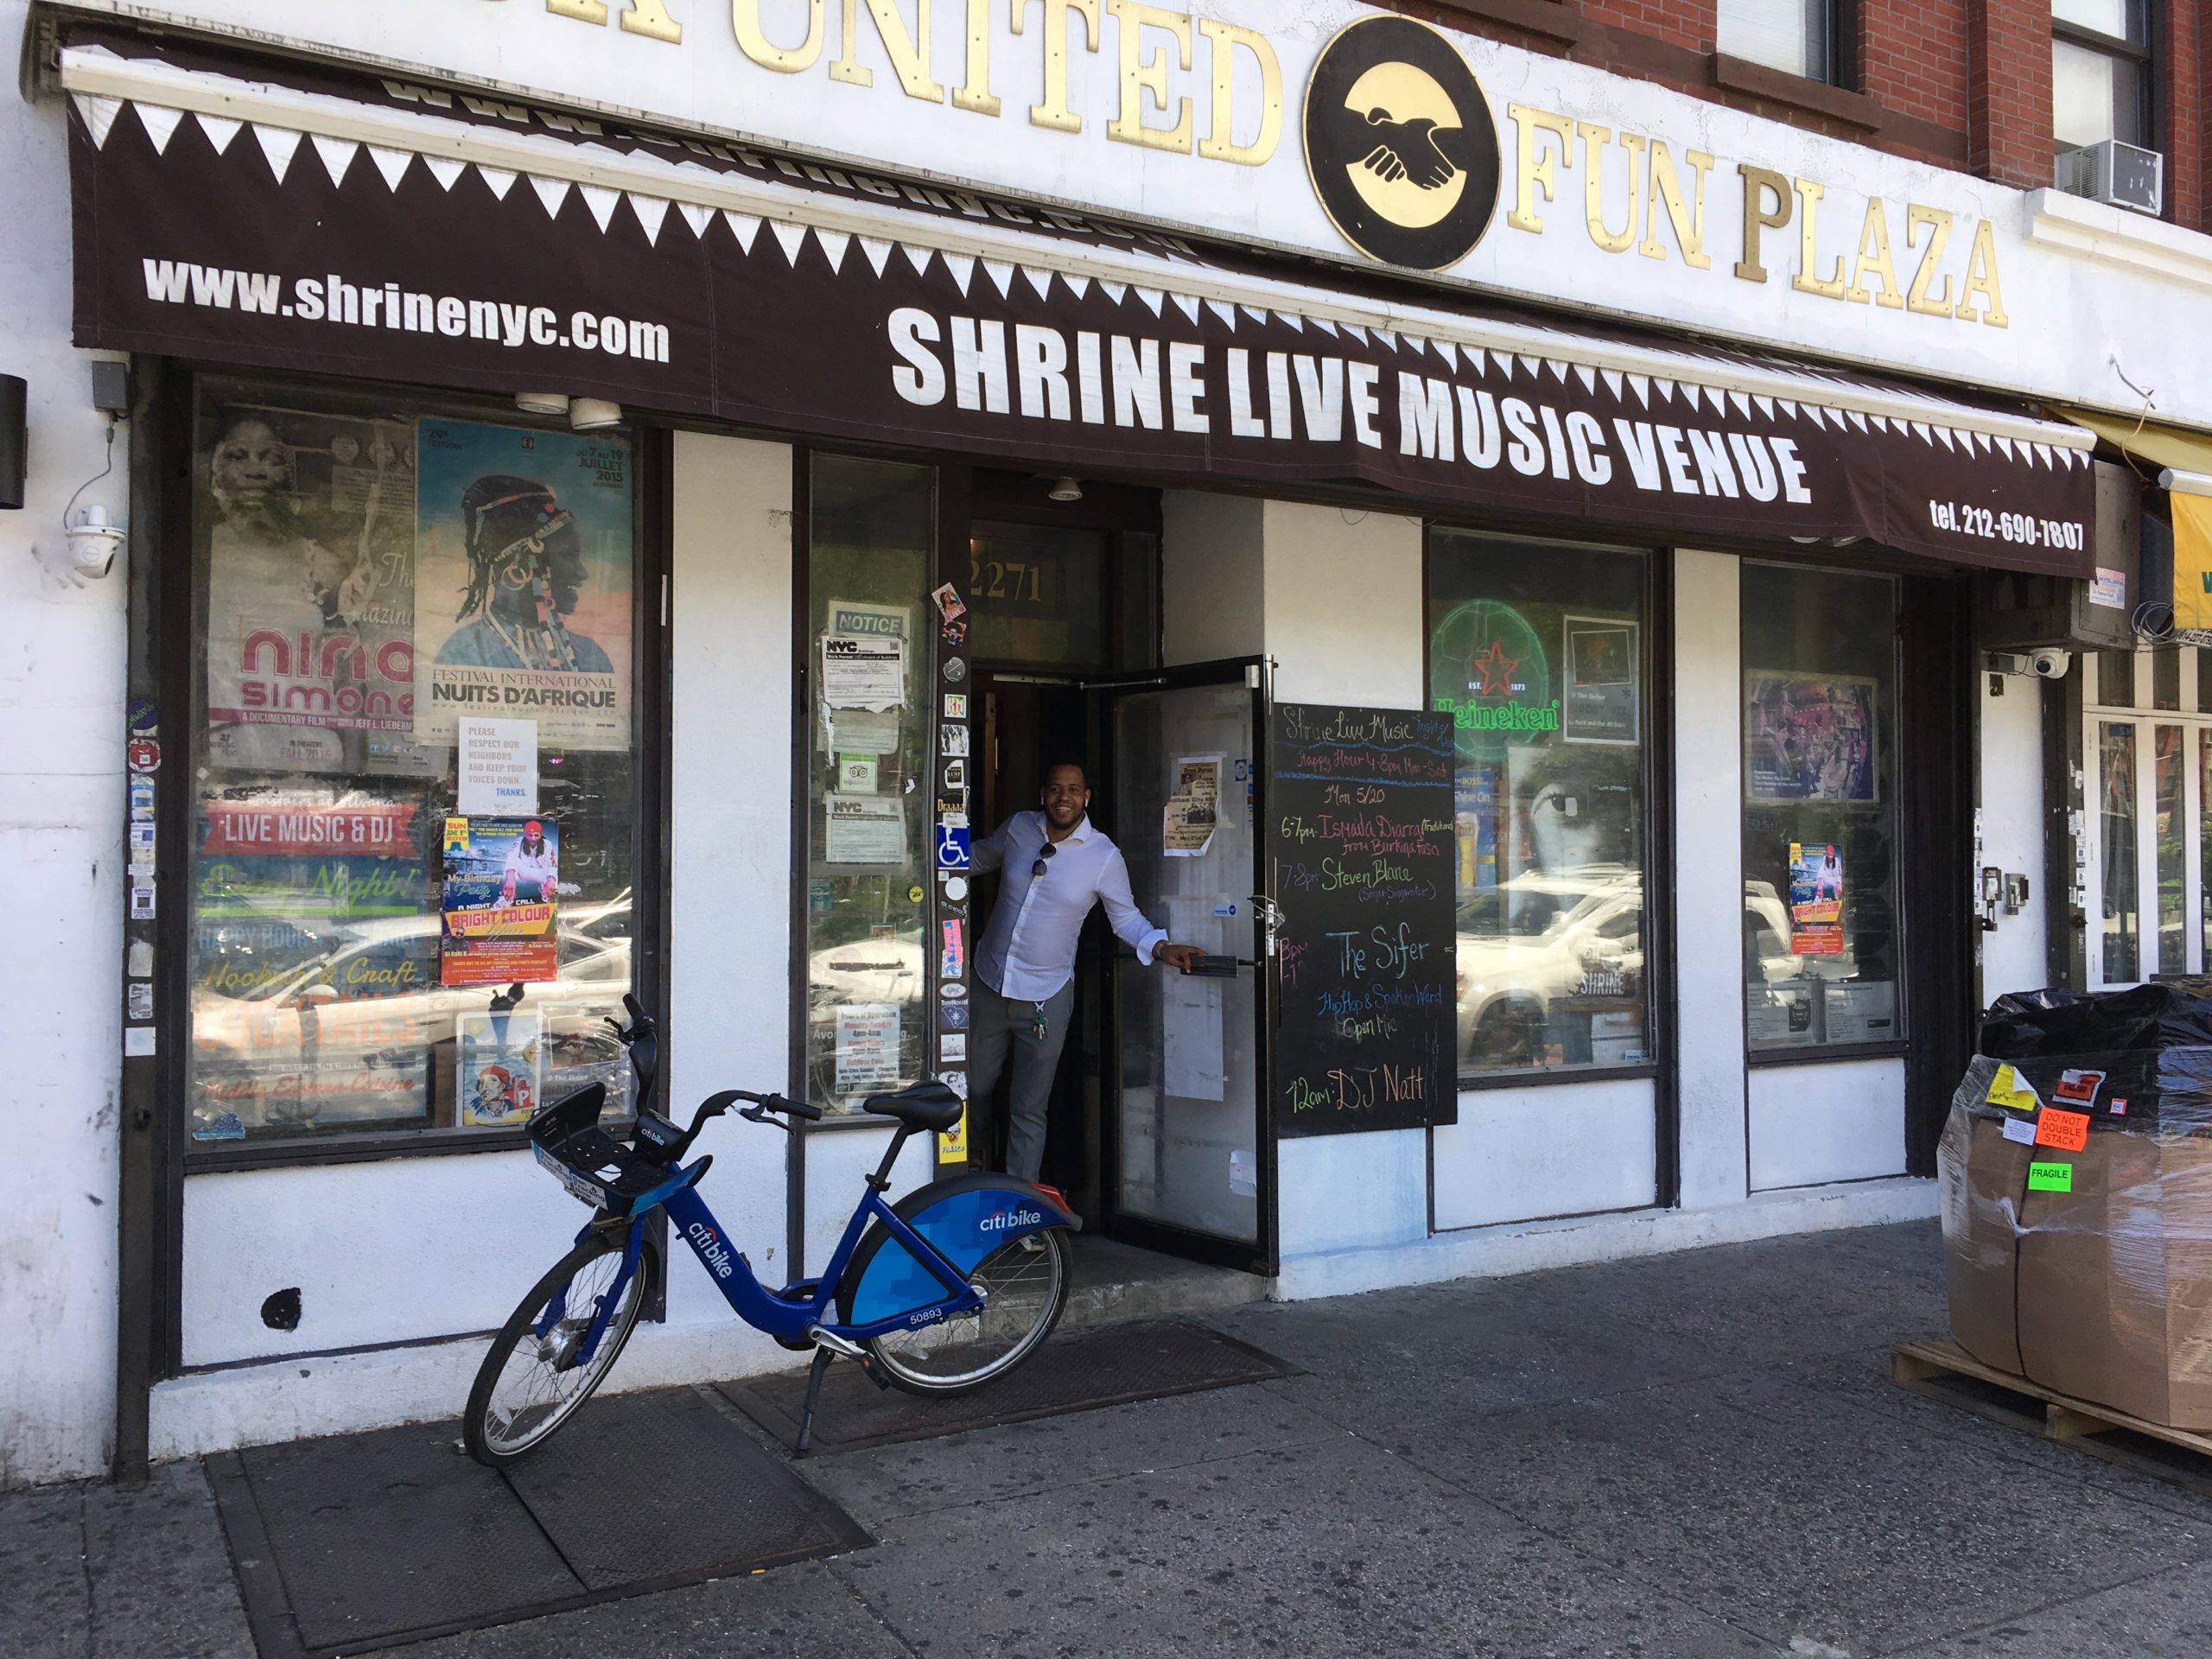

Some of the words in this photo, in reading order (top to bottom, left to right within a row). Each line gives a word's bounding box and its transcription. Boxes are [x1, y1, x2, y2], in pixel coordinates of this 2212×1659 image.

[1507, 101, 1715, 270] FUN
[1734, 163, 2010, 329] PLAZA
[143, 258, 670, 364] www.shrinenyc.com
[888, 308, 1210, 434] SHRINE
[1227, 347, 1382, 448] LIVE
[1398, 371, 1612, 486] MUSIC
[1612, 417, 1811, 504] VENUE
[612, 448, 623, 460] 19
[578, 457, 622, 471] JUILLET
[596, 470, 623, 482] 2015
[1929, 499, 1961, 532] tel.
[1962, 505, 2083, 550] 212-690-7807
[970, 559, 1042, 601] 2271
[839, 614, 900, 633] NOTICE
[827, 640, 857, 652] NYC
[433, 670, 495, 683] FESTIVAL
[501, 673, 616, 689] INTERNATIONAL
[1469, 682, 1483, 690] EST.
[241, 680, 414, 716] simone
[433, 683, 500, 702] NUITS
[505, 687, 616, 709] D'AFRIQUE
[249, 713, 305, 726] DOCUMENTARY
[307, 715, 326, 726] FILM
[355, 719, 372, 728] JEFF
[1335, 710, 1369, 741] Live
[1369, 713, 1414, 744] Music
[468, 727, 496, 735] PLEASE
[281, 747, 303, 759] FALL
[468, 740, 501, 748] RESPECT
[503, 741, 519, 749] OUR
[468, 752, 512, 760] NEIGHBORS
[1298, 749, 1332, 773] Happy
[468, 775, 495, 784] VOICES
[1462, 777, 1480, 785] BOSS
[1325, 785, 1350, 804] Mon
[1357, 785, 1385, 804] 5/20
[1477, 791, 1491, 803] On
[834, 801, 862, 813] NYC
[225, 814, 272, 842] LIVE
[278, 815, 345, 843] MUSIC
[351, 817, 365, 843] &
[371, 816, 393, 843] DJ
[1341, 838, 1369, 856] from
[1370, 838, 1417, 858] Burkina
[448, 874, 461, 884] My
[461, 874, 501, 885] Birthday
[1322, 857, 1372, 891] Steven
[1372, 858, 1414, 888] Blane
[451, 912, 498, 929] BRIGHT
[501, 906, 550, 925] COLOUR
[1325, 931, 1366, 979] The
[1371, 921, 1430, 980] Sifer
[346, 957, 418, 987] Craft
[1580, 972, 1624, 995] SHRINE
[1412, 982, 1442, 1006] Word
[1342, 1017, 1375, 1040] Open
[1376, 1014, 1397, 1039] Mic
[1327, 1068, 1377, 1110] DJ
[1383, 1065, 1424, 1103] Natt
[2046, 1112, 2061, 1122] DO
[2062, 1114, 2082, 1126] NOT
[650, 1131, 665, 1147] bike
[2042, 1122, 2082, 1137] DOUBLE
[2044, 1133, 2075, 1147] STACK
[2031, 1168, 2069, 1179] FRAGILE
[980, 1211, 1006, 1231] citi
[1007, 1210, 1041, 1228] bike
[689, 1223, 716, 1249] citi
[704, 1242, 733, 1279] bike
[910, 1307, 943, 1325] 50893
